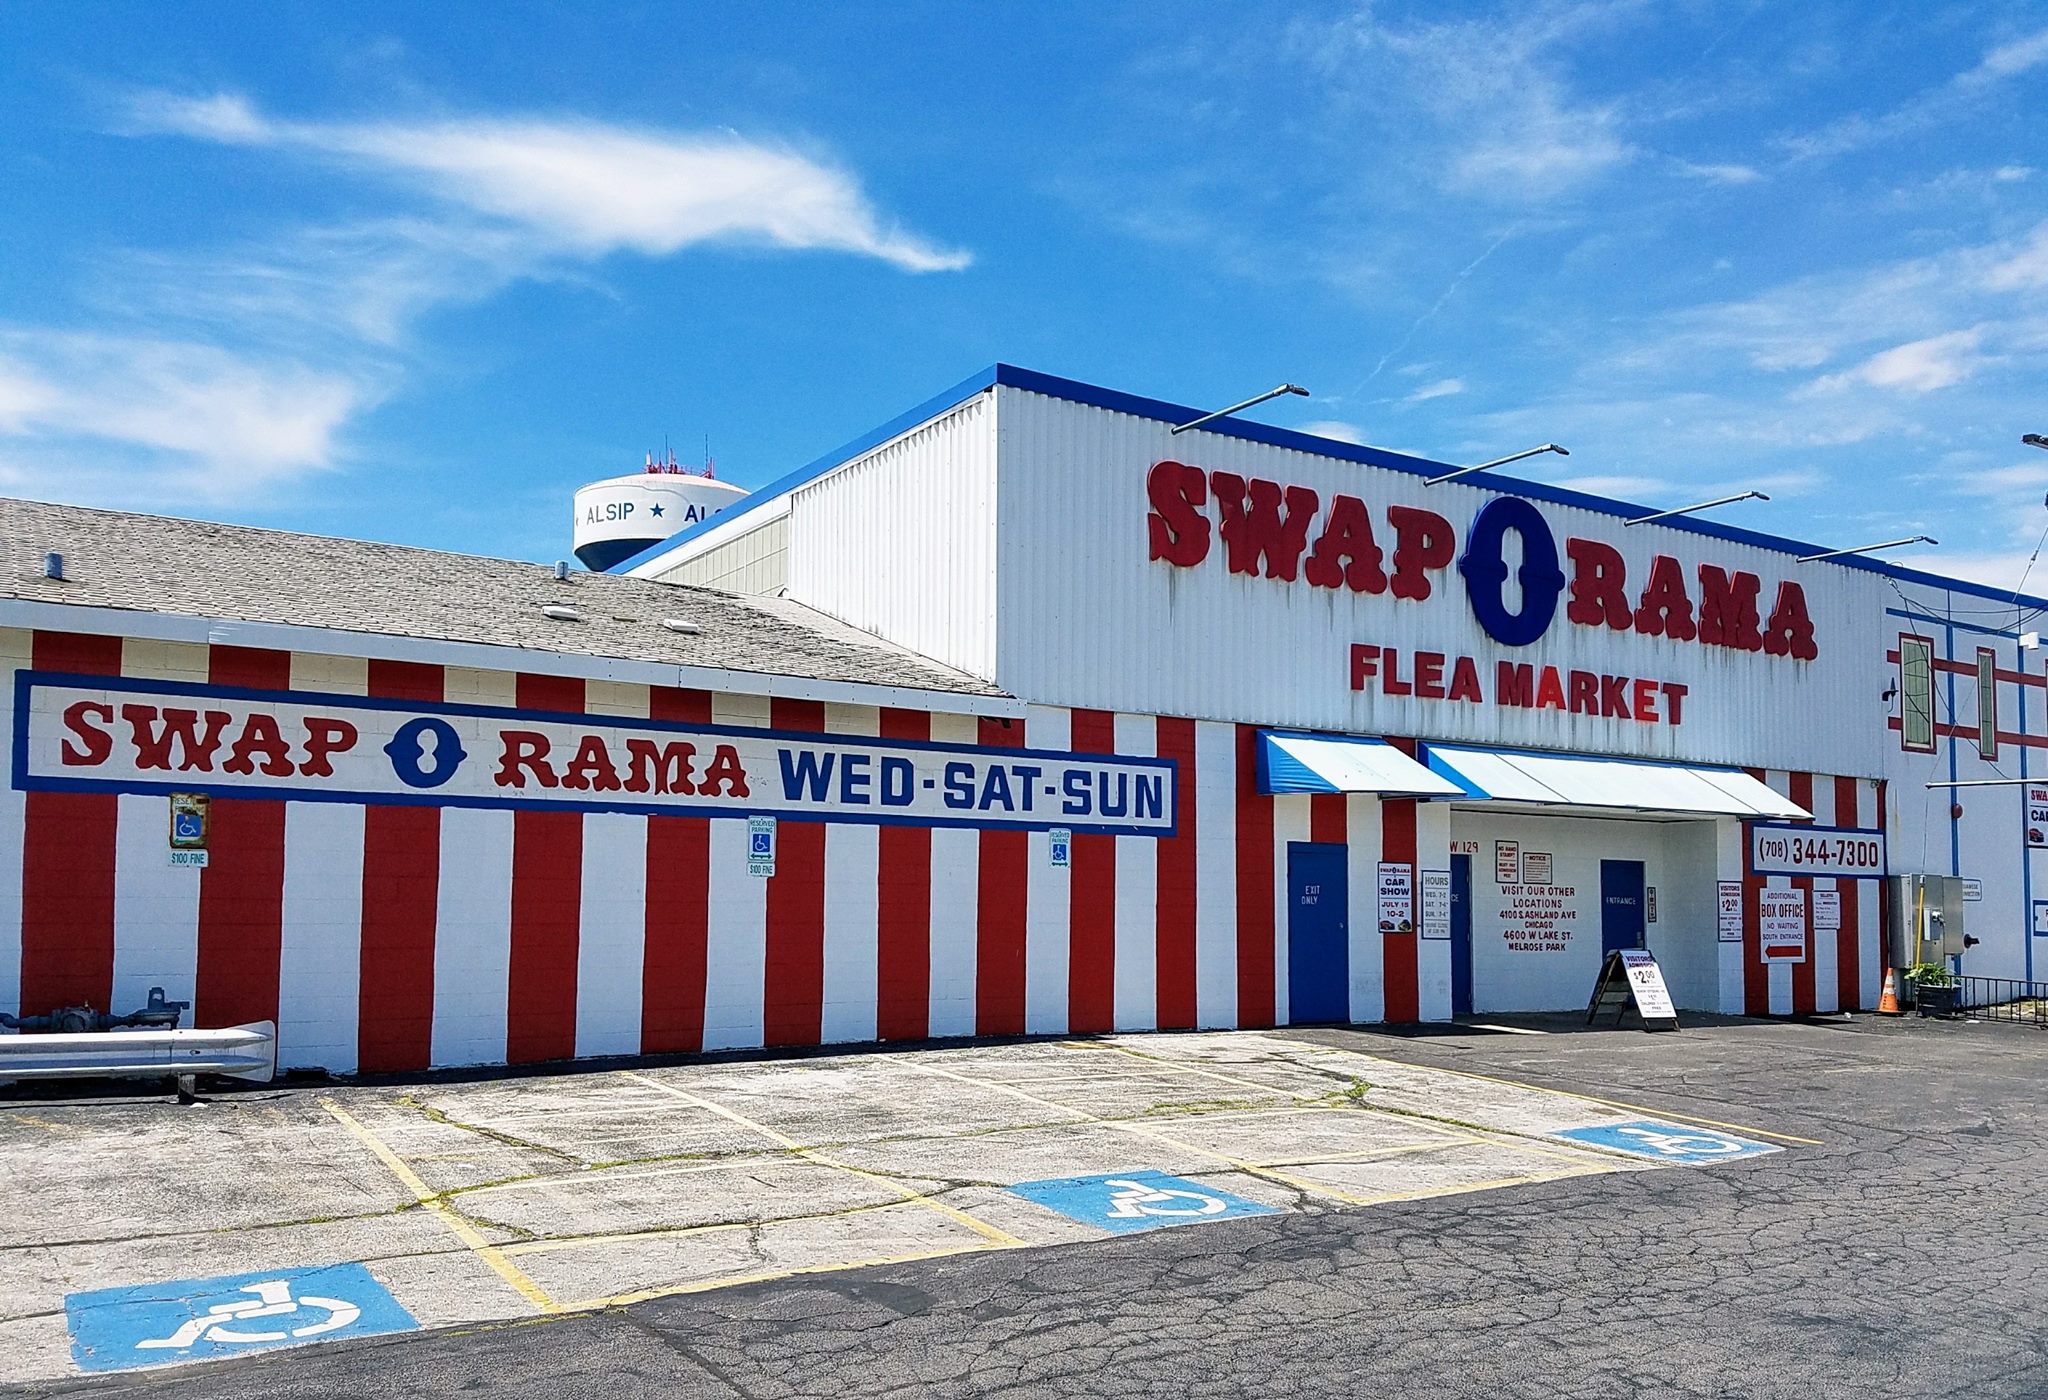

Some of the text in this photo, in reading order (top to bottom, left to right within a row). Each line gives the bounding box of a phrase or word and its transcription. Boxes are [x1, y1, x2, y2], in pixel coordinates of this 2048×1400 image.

[586, 502, 635, 526] ALSIP
[1147, 460, 1818, 661] SWAP O RAMA
[1350, 643, 1689, 726] FLEA MARKET
[61, 701, 1163, 819] SWAP O RAMA WED-SAT-SUN
[1463, 841, 1479, 853] 129
[1759, 836, 1878, 868] (708) 344-7300
[171, 852, 205, 864] $100 FINE
[750, 864, 773, 875] $100 FINE
[1385, 878, 1405, 887] CAR
[1425, 876, 1449, 886] HOURS
[1305, 885, 1320, 895] EXIT
[1380, 887, 1410, 896] SHOW
[1501, 885, 1575, 896] VISIT OUR OTHER
[1301, 895, 1318, 905] ONLY
[1606, 896, 1637, 905] ENTRANCE
[1767, 892, 1798, 900] ADDITIONAL
[1513, 898, 1562, 908] LOCATIONS
[1499, 910, 1517, 919] 4100
[1525, 910, 1559, 919] ASHLAND
[1561, 910, 1576, 919] AVE
[1761, 903, 1804, 918] BOX OFFICE
[1524, 920, 1553, 929] CHICAGO
[1767, 922, 1799, 930] NO WAITING
[1503, 930, 1573, 941] 4600 W LAKE ST.
[1508, 942, 1566, 951] MELROSE PARK
